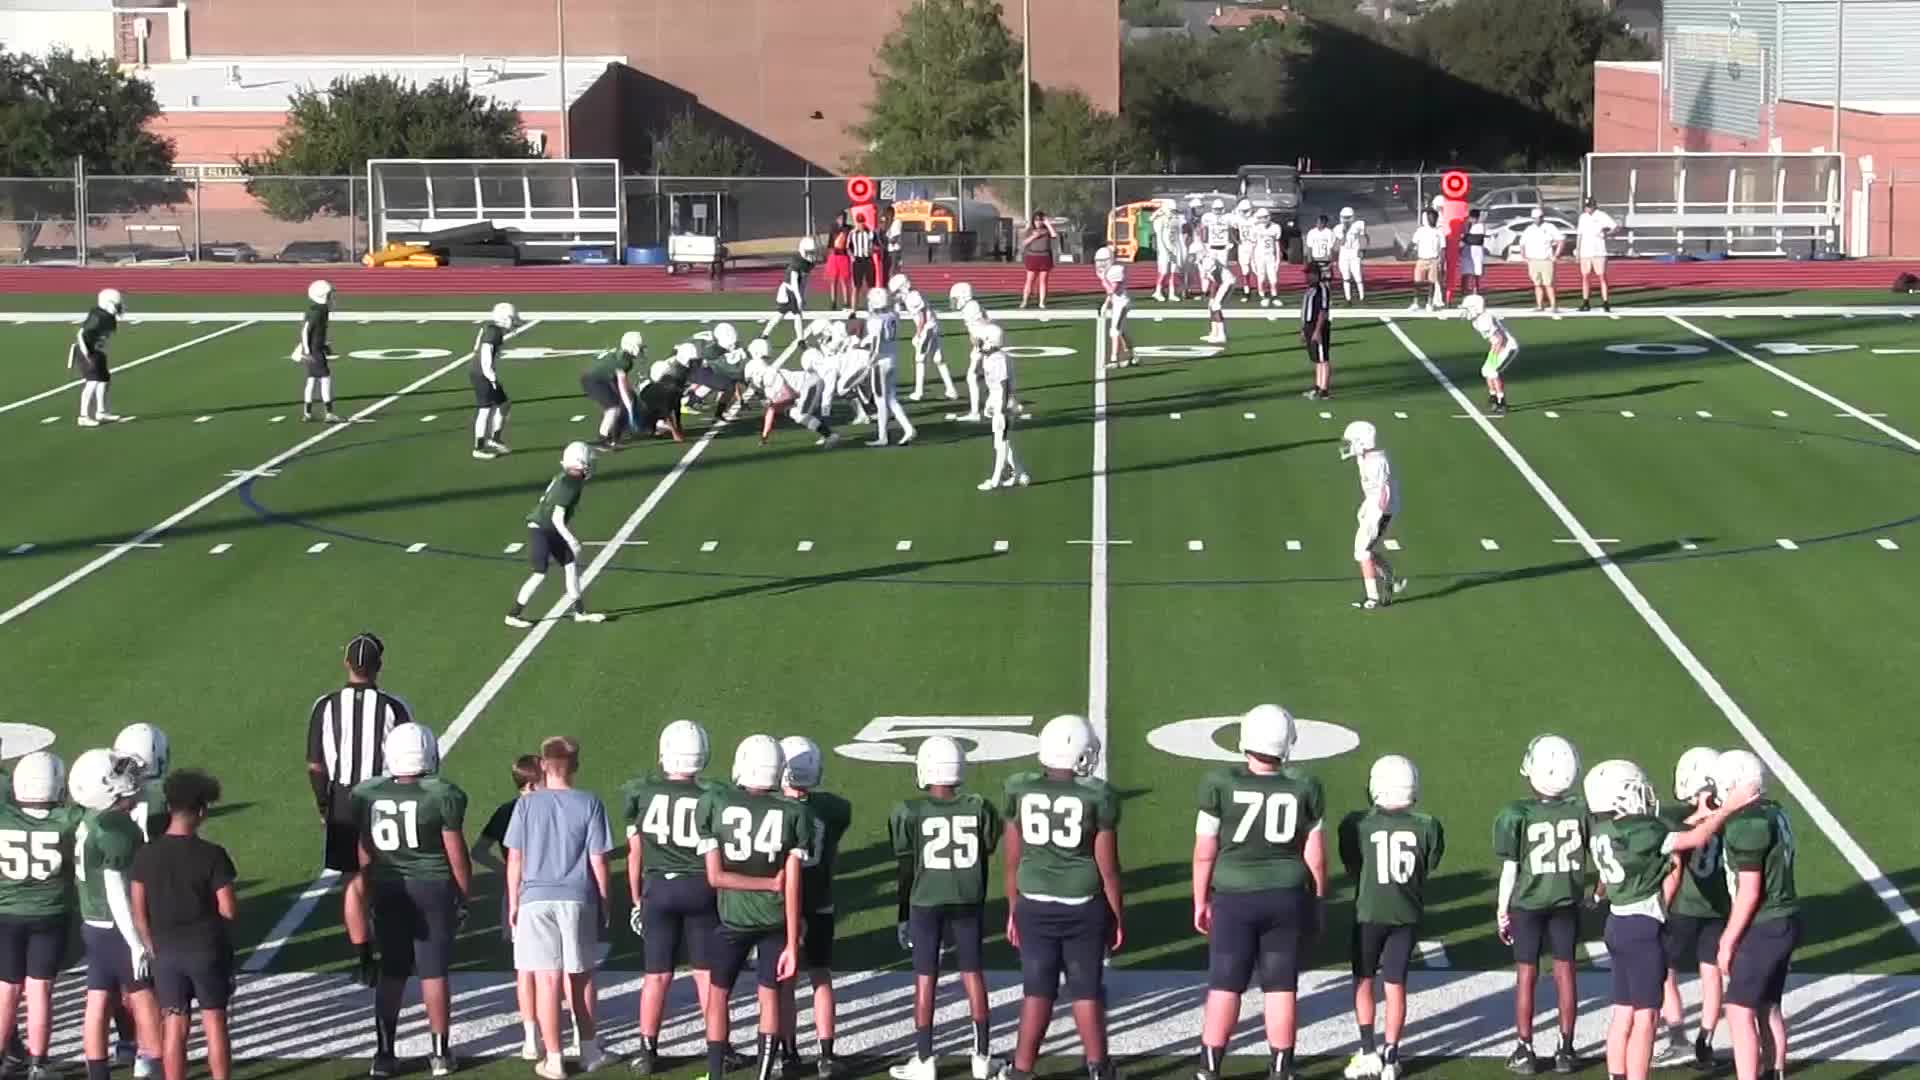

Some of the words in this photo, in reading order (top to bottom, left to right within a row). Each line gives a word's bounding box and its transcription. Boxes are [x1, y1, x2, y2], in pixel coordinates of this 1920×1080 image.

[370, 799, 420, 852] 61
[642, 794, 700, 847] 40
[720, 806, 784, 863] 34
[921, 816, 979, 869] 25
[1020, 793, 1084, 849] 63
[1232, 790, 1299, 844] 70
[0, 829, 63, 881] 55
[1370, 830, 1417, 885] 16
[1527, 818, 1582, 875] 22
